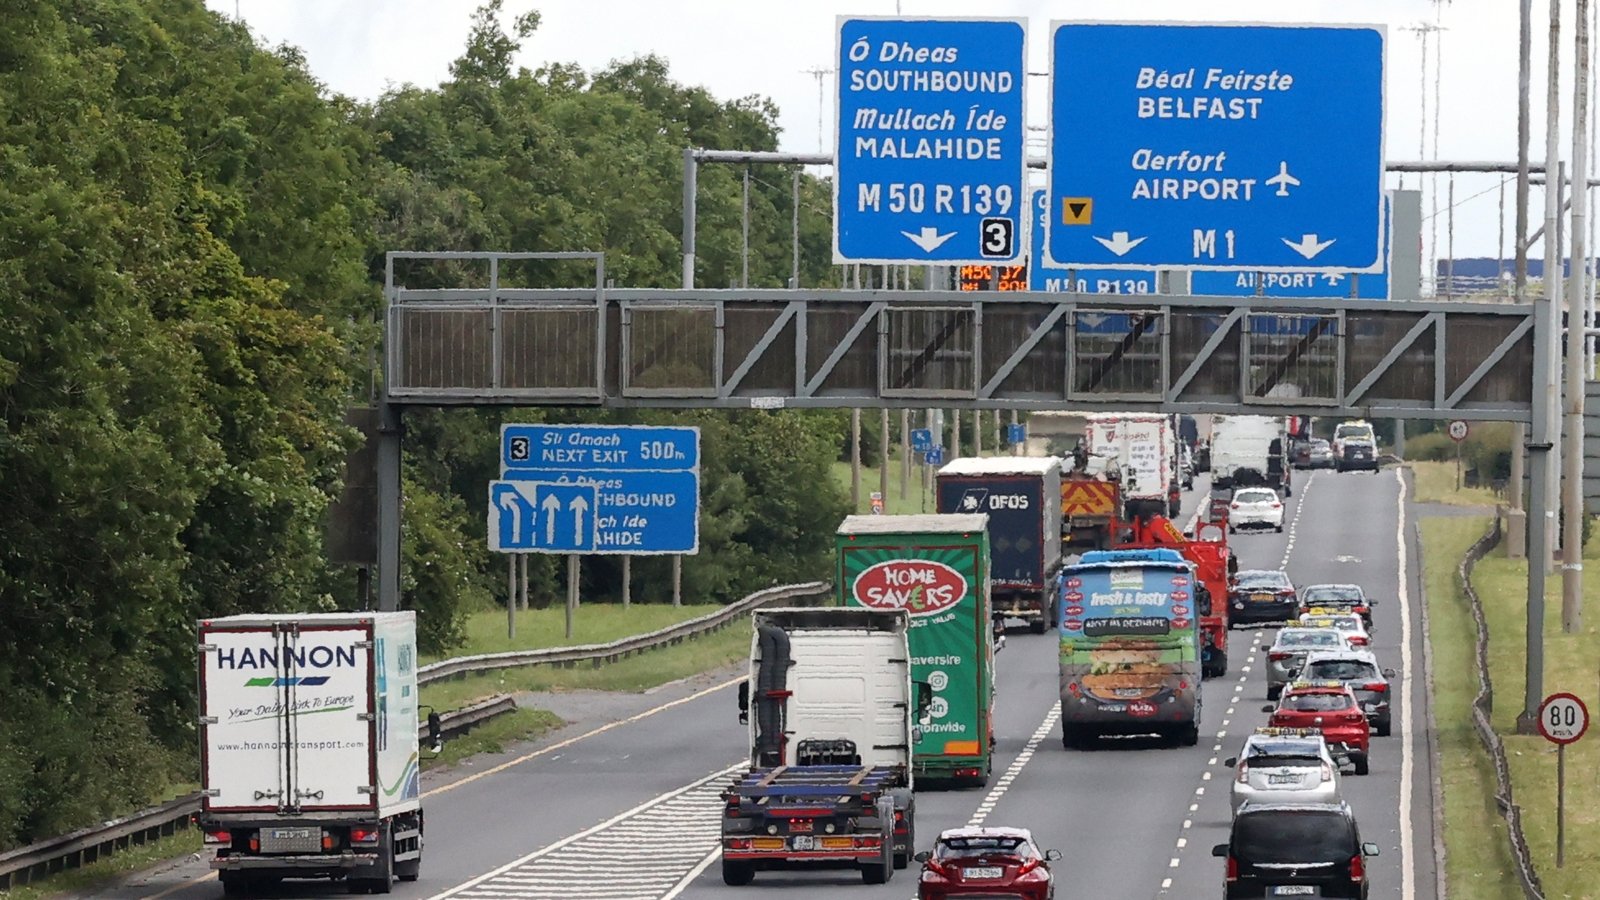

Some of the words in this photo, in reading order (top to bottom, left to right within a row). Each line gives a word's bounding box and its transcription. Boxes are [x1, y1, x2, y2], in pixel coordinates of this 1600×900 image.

[849, 35, 870, 62] Ó
[879, 41, 958, 63] Dheas
[850, 68, 1013, 93] SOUTHBOUND
[1135, 67, 1195, 89] Béal
[1203, 68, 1293, 92] Feirste
[853, 108, 956, 131] Mullach
[965, 104, 1007, 131] Íde
[1137, 96, 1263, 120] BELFAST
[855, 136, 1001, 160] MALAHIDE
[1131, 148, 1226, 172] Aerfort
[1132, 178, 1257, 201] AIRPORT
[985, 222, 1007, 253] 3
[512, 440, 526, 458] 3
[542, 449, 586, 462] NEXT
[593, 450, 628, 463] EXIT
[883, 566, 937, 586] HOME
[217, 645, 356, 669] HANNON
[1550, 705, 1575, 727] 80
